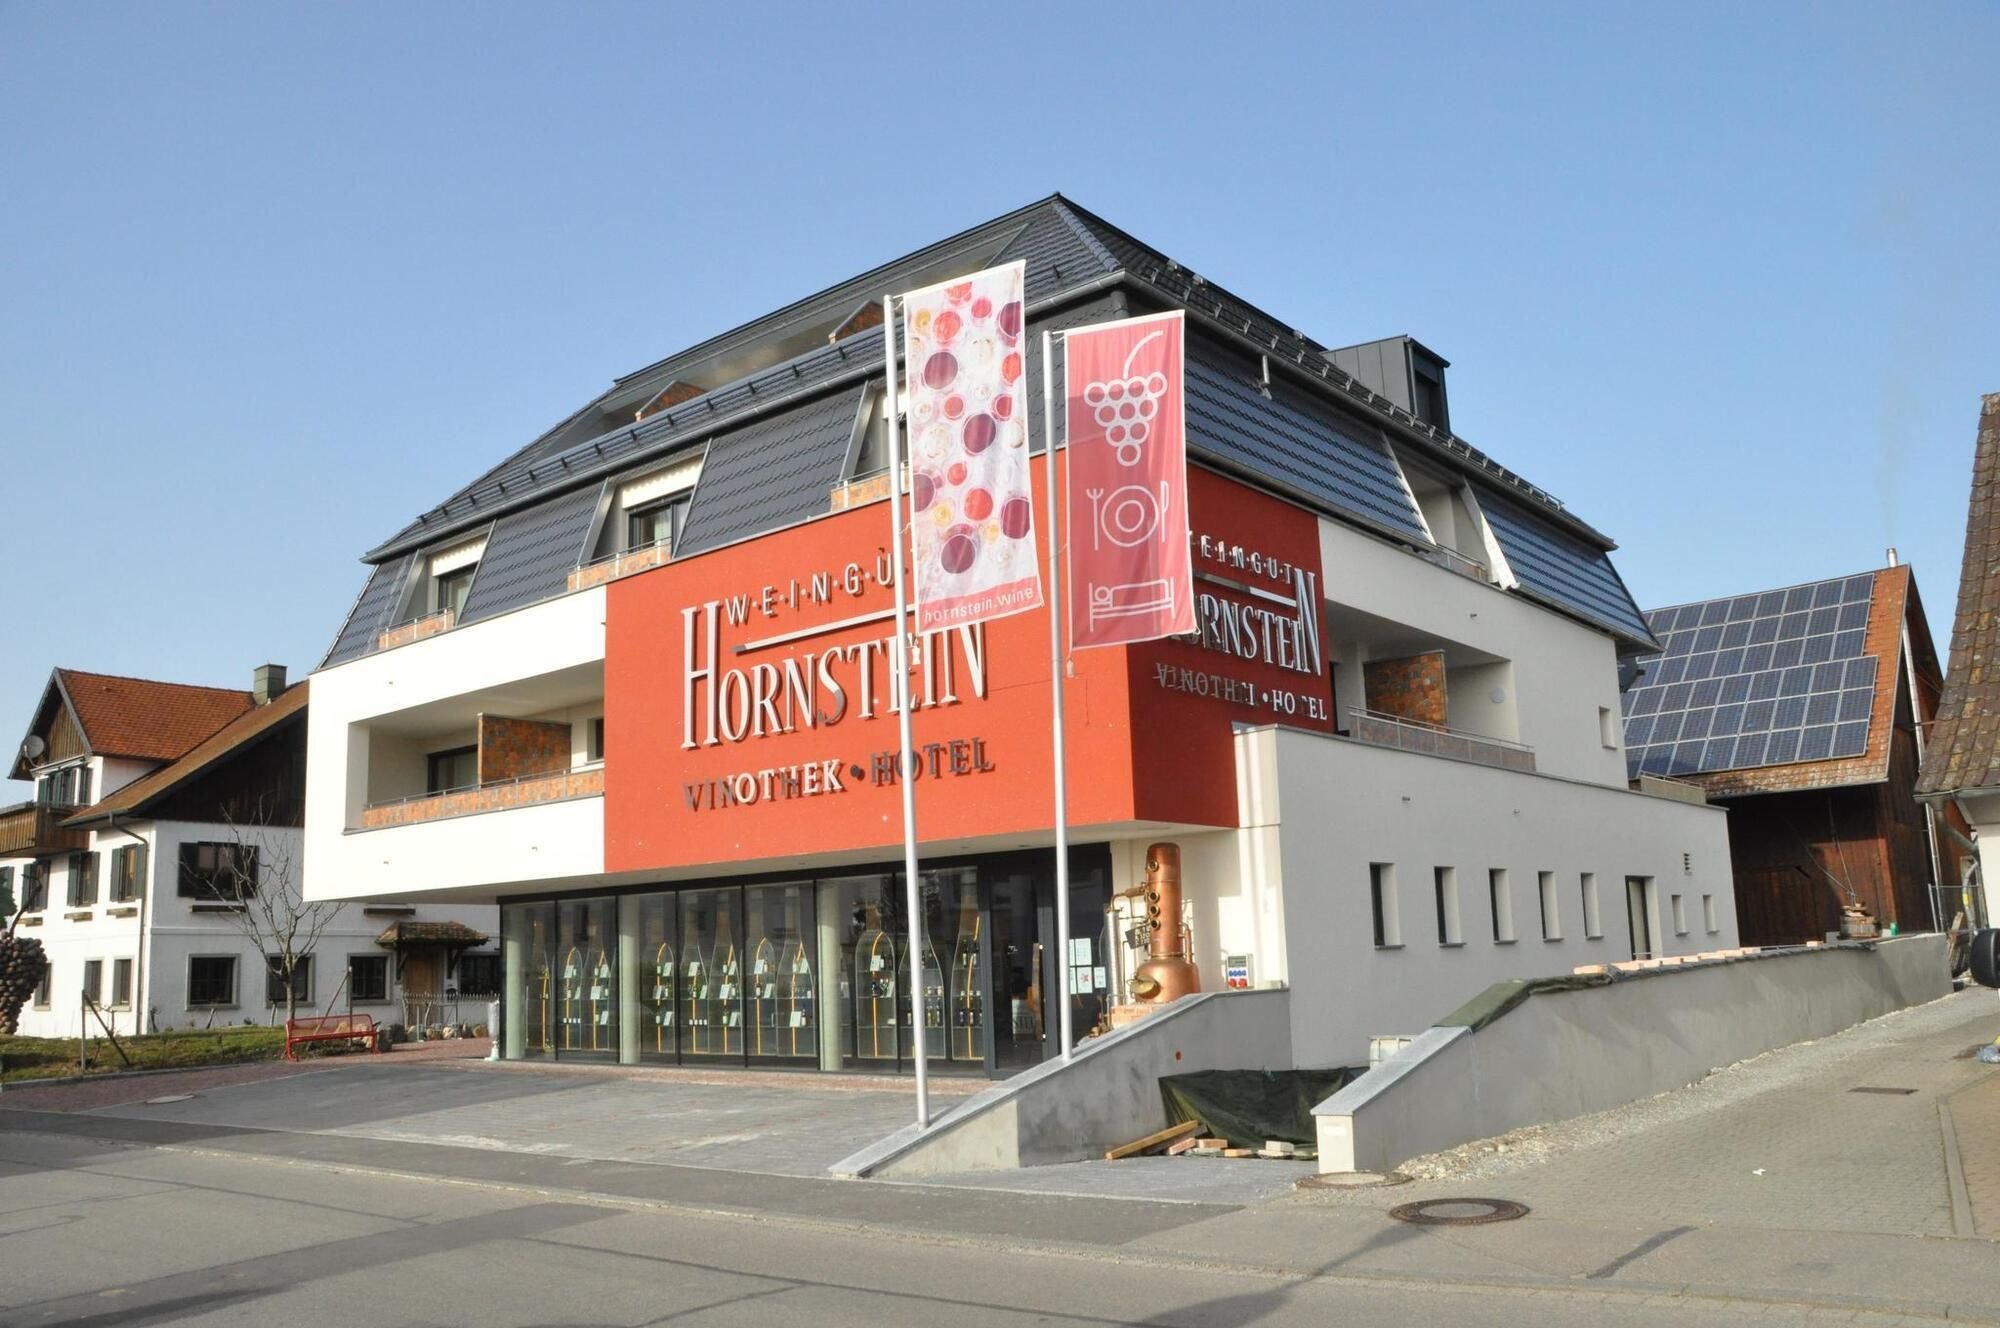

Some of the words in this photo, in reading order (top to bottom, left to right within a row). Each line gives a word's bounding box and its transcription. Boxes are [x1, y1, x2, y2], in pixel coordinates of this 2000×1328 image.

[923, 586, 1035, 625] hornstein.wine
[1168, 568, 1321, 676] RNSTEIN
[1271, 689, 1327, 720] HOEL
[682, 758, 844, 809] VINOTHEK
[869, 737, 992, 785] HOTEL
